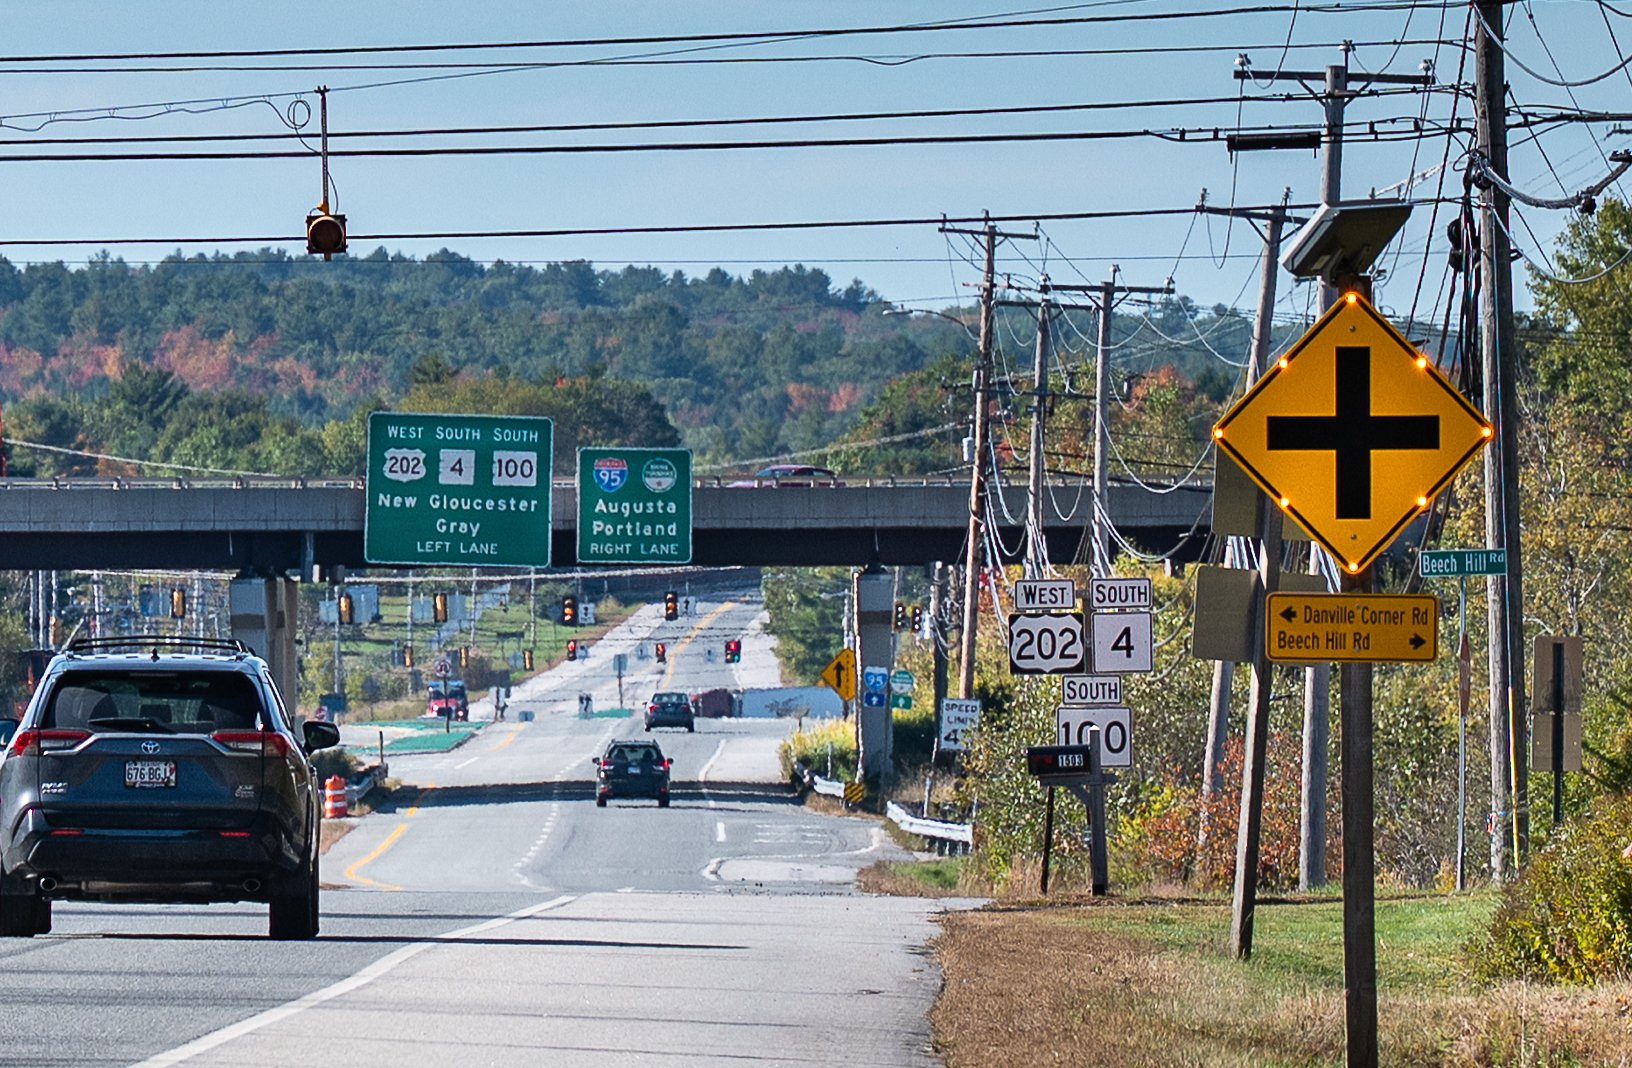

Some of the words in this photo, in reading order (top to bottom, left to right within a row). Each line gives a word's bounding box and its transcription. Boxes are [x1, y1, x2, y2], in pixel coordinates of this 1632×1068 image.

[387, 425, 424, 439] WEST
[435, 426, 481, 441] SOUTH
[493, 427, 539, 443] SOUTH
[388, 455, 421, 475] 202
[449, 457, 464, 477] 4
[496, 458, 534, 479] 100
[599, 470, 621, 486] 95
[378, 493, 418, 508] New
[429, 494, 538, 512] Gloucester
[594, 498, 677, 518] Augusta
[436, 518, 481, 537] Gray
[592, 520, 677, 536] Portland
[416, 541, 451, 553] LEFT
[459, 542, 498, 555] LANE
[590, 543, 632, 555] RIGHT
[640, 543, 679, 555] LANE
[1422, 554, 1457, 573] Beech
[1465, 552, 1487, 572] Hill
[1489, 552, 1504, 563] Rd
[1023, 585, 1067, 605] WEST
[1095, 584, 1148, 604] SOUTH
[1303, 605, 1355, 625] Danville
[1361, 606, 1406, 625] Corner
[1412, 606, 1428, 625] Rd
[1015, 627, 1078, 661] 202
[1110, 626, 1135, 659] 4
[1277, 630, 1320, 650] Beech
[1325, 631, 1347, 650] Hill
[1353, 631, 1370, 651] Rd
[868, 675, 884, 687] 95
[1066, 680, 1118, 700] SOUTH
[944, 702, 978, 713] SPEED
[1061, 720, 1128, 754] 100
